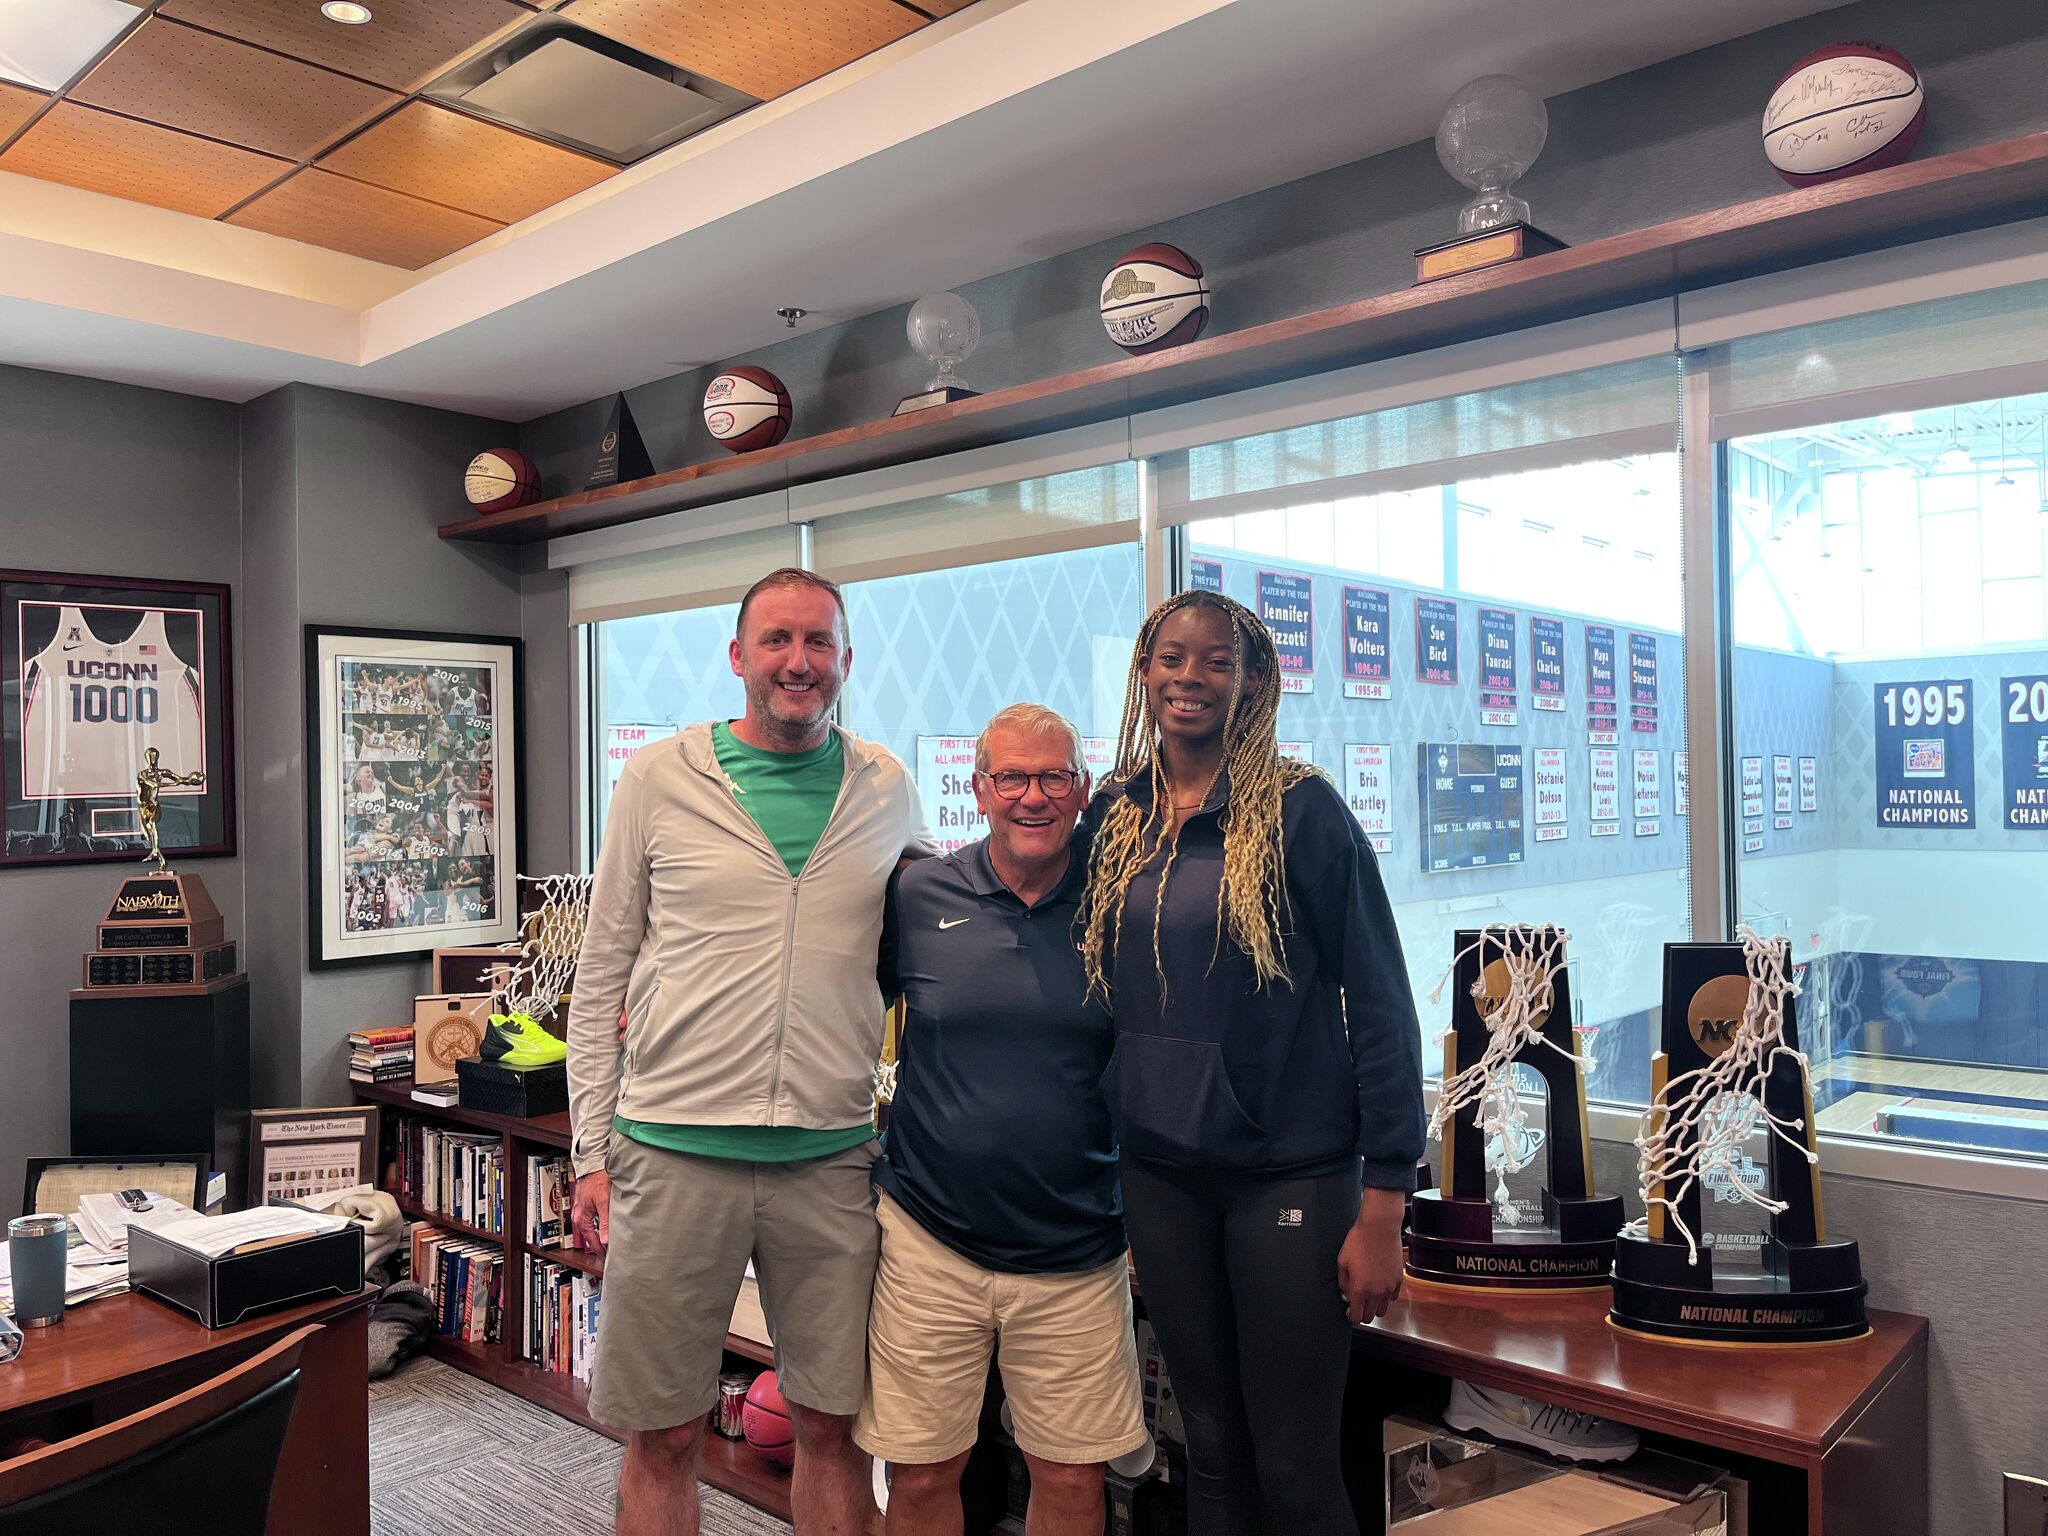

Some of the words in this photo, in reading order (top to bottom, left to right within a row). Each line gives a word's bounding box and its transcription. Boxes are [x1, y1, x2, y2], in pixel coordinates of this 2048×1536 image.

[1262, 587, 1280, 596] PLAYER
[1264, 602, 1308, 622] Jennifer
[1356, 616, 1378, 634] Kara
[1430, 625, 1445, 641] Sue
[1350, 637, 1384, 656] Wolters
[1488, 634, 1508, 650] Diana
[1541, 642, 1556, 656] Tina
[1429, 646, 1446, 662] Bird
[1486, 654, 1512, 670] Taurasi
[1536, 659, 1560, 674] Charles
[67, 660, 158, 681] UCONN
[432, 669, 460, 684] 2010
[1282, 678, 1303, 690] 94-95
[70, 684, 158, 724] 1000
[398, 696, 424, 710] 1995
[1884, 685, 1965, 727] 1995
[2009, 681, 2048, 723] 20
[466, 717, 492, 730] 2015
[616, 729, 645, 740] TEAM
[940, 740, 960, 749] FIRST
[964, 740, 976, 749] TEA
[1089, 741, 1106, 749] TEAM
[400, 746, 426, 760] 2013
[935, 754, 974, 764] ALL-AMERI
[1496, 754, 1521, 766] UCONN
[942, 774, 972, 796] She
[1360, 772, 1378, 788] Bria
[1436, 778, 1454, 790] HOME
[1500, 777, 1518, 789] GUEST
[1536, 772, 1564, 785] Stefanie
[1540, 791, 1562, 804] Dolson
[1889, 790, 1962, 804] NATIONAL
[349, 798, 382, 812] 2000
[388, 798, 420, 812] 2004
[1352, 795, 1386, 814] Hartley
[1883, 808, 1968, 823] CHAMPIONS
[462, 822, 492, 836] 2009
[1361, 820, 1383, 830] 011-12
[371, 846, 399, 858] 2014
[416, 844, 446, 857] 2003
[462, 902, 488, 914] 2016
[350, 911, 382, 923] 2002
[310, 1124, 325, 1132] York
[1492, 1215, 1544, 1223] CHAONSHIP
[1716, 1234, 1770, 1245] BASKETBALL
[1456, 1256, 1526, 1272] NATIONAL
[1530, 1258, 1598, 1272] CHAMPION
[1680, 1305, 1748, 1322] NATIONAL
[1753, 1309, 1825, 1324] CHAMPION
